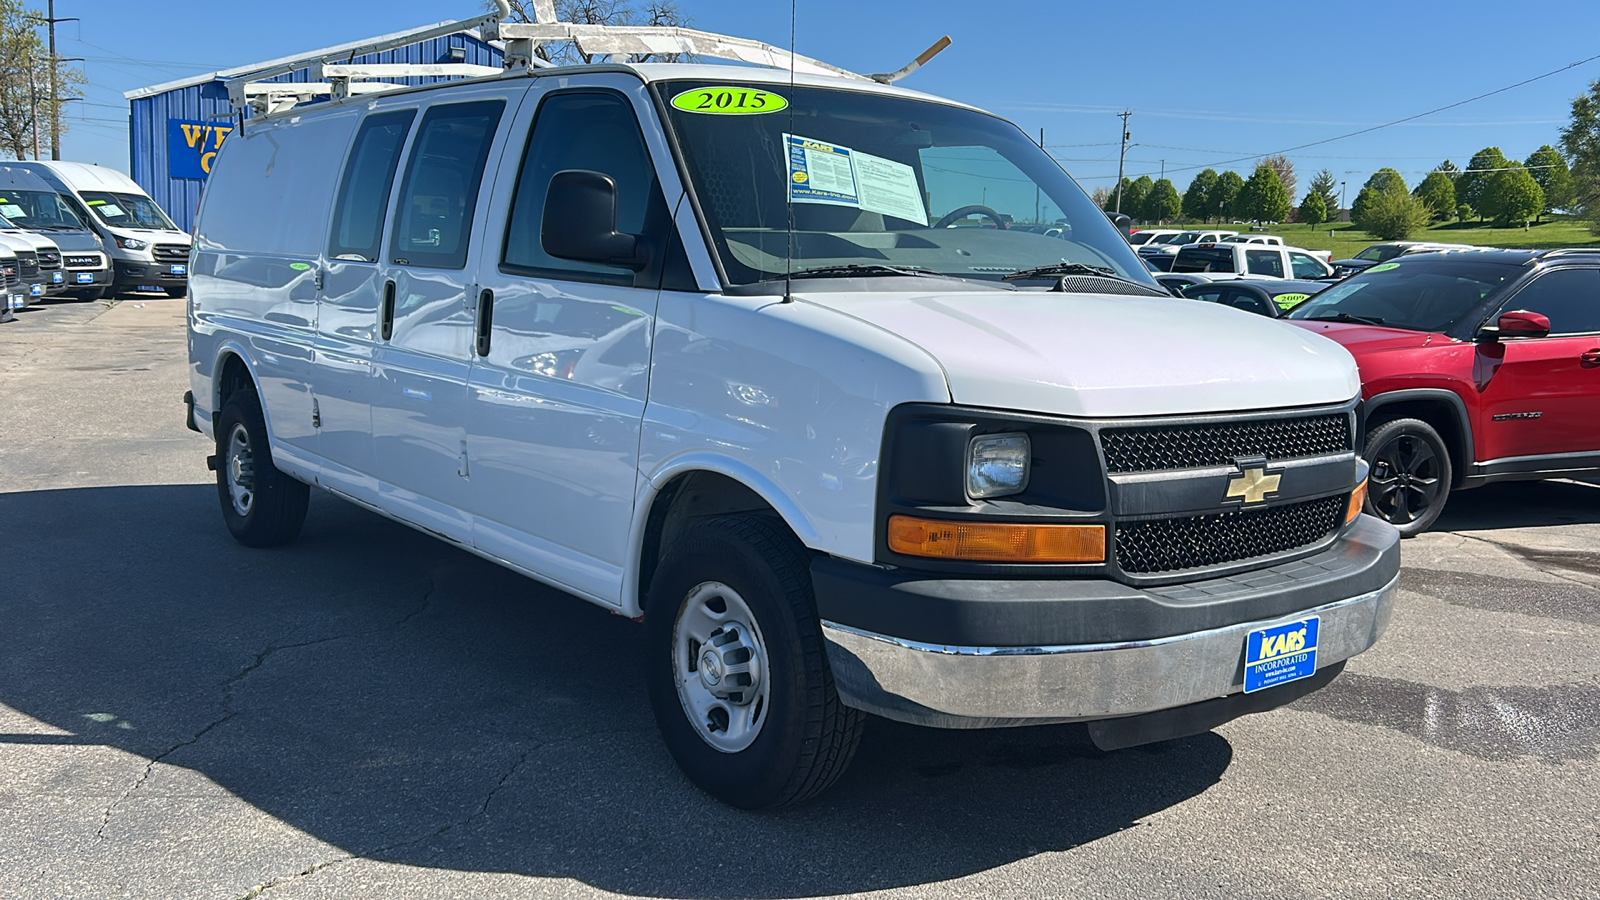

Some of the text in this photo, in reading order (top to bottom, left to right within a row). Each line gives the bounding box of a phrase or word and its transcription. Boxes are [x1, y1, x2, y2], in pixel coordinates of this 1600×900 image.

[696, 92, 767, 109] 2015
[1259, 628, 1307, 660] KARS
[1254, 653, 1308, 674] INCORPORATED
